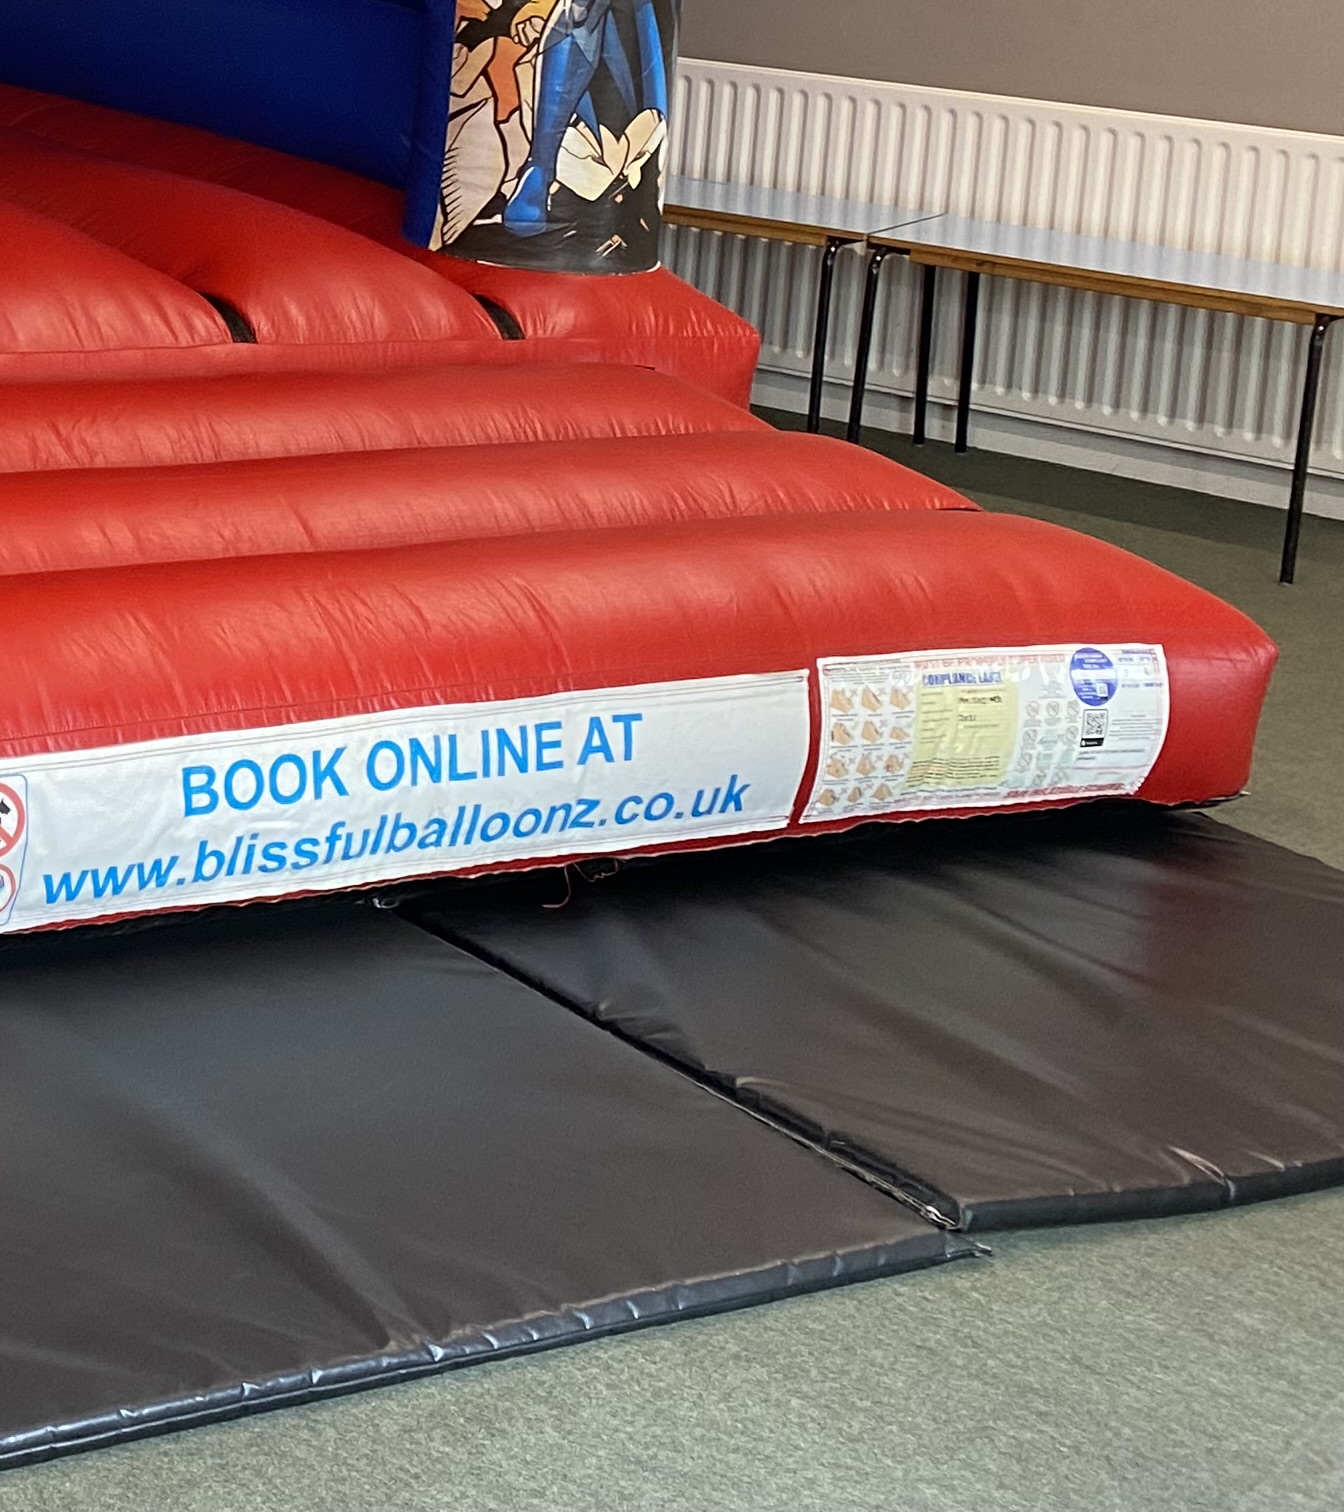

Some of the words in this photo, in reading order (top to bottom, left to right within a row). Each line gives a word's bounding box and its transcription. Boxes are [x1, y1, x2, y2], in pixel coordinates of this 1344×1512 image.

[182, 748, 349, 818] BOOK
[366, 721, 564, 792] ONLINE
[577, 713, 643, 766] AT
[43, 774, 750, 905] www.blissfulballoonz.co.uk
